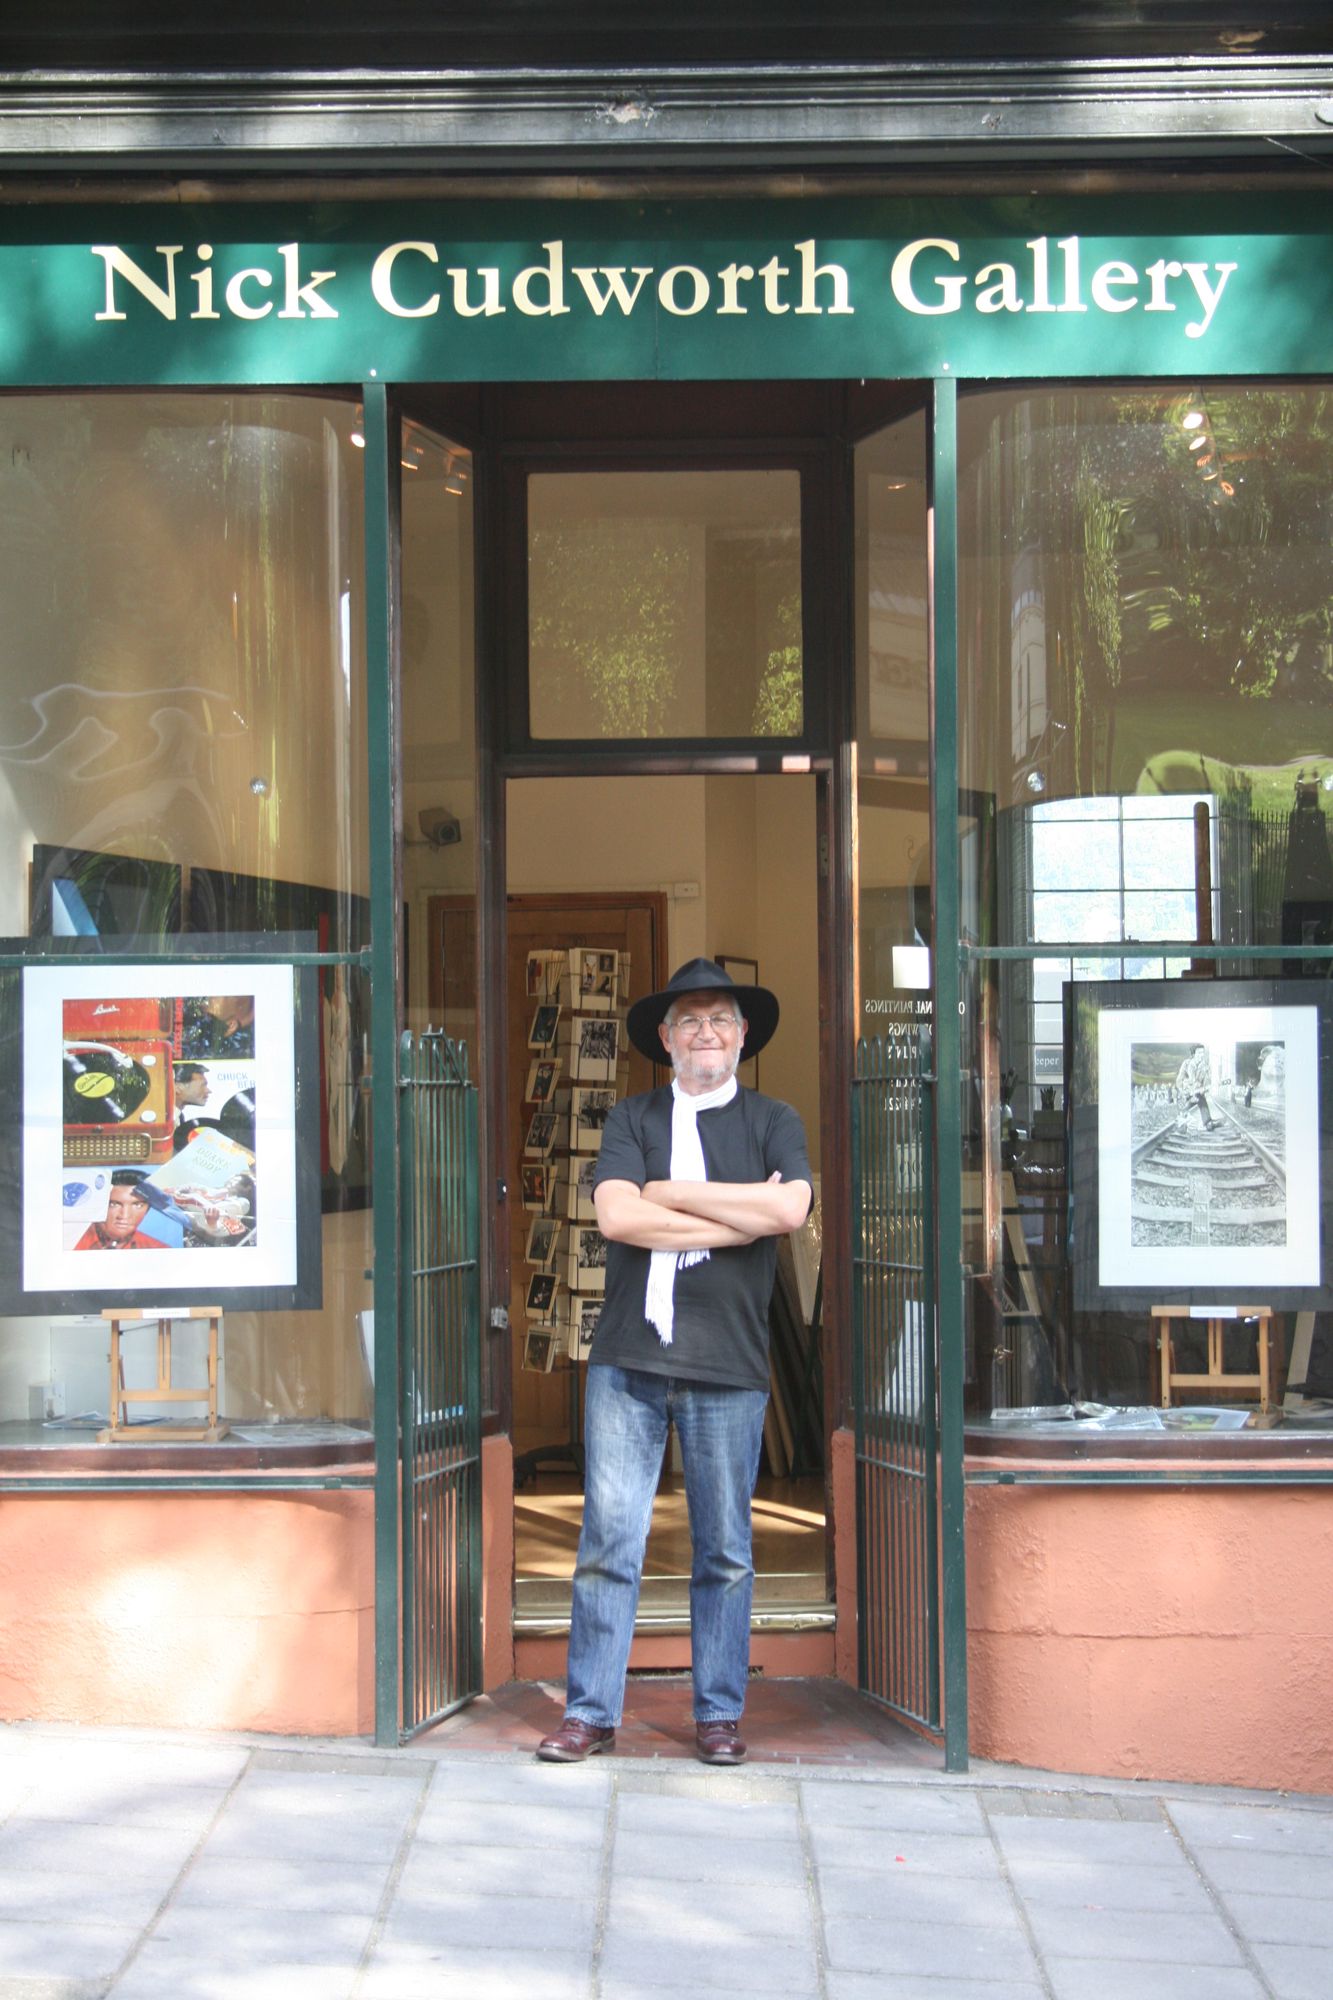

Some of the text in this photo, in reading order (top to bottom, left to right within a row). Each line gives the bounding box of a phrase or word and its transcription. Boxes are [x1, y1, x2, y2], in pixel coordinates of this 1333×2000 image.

[90, 236, 1239, 343] Nick Cudworth Gallery
